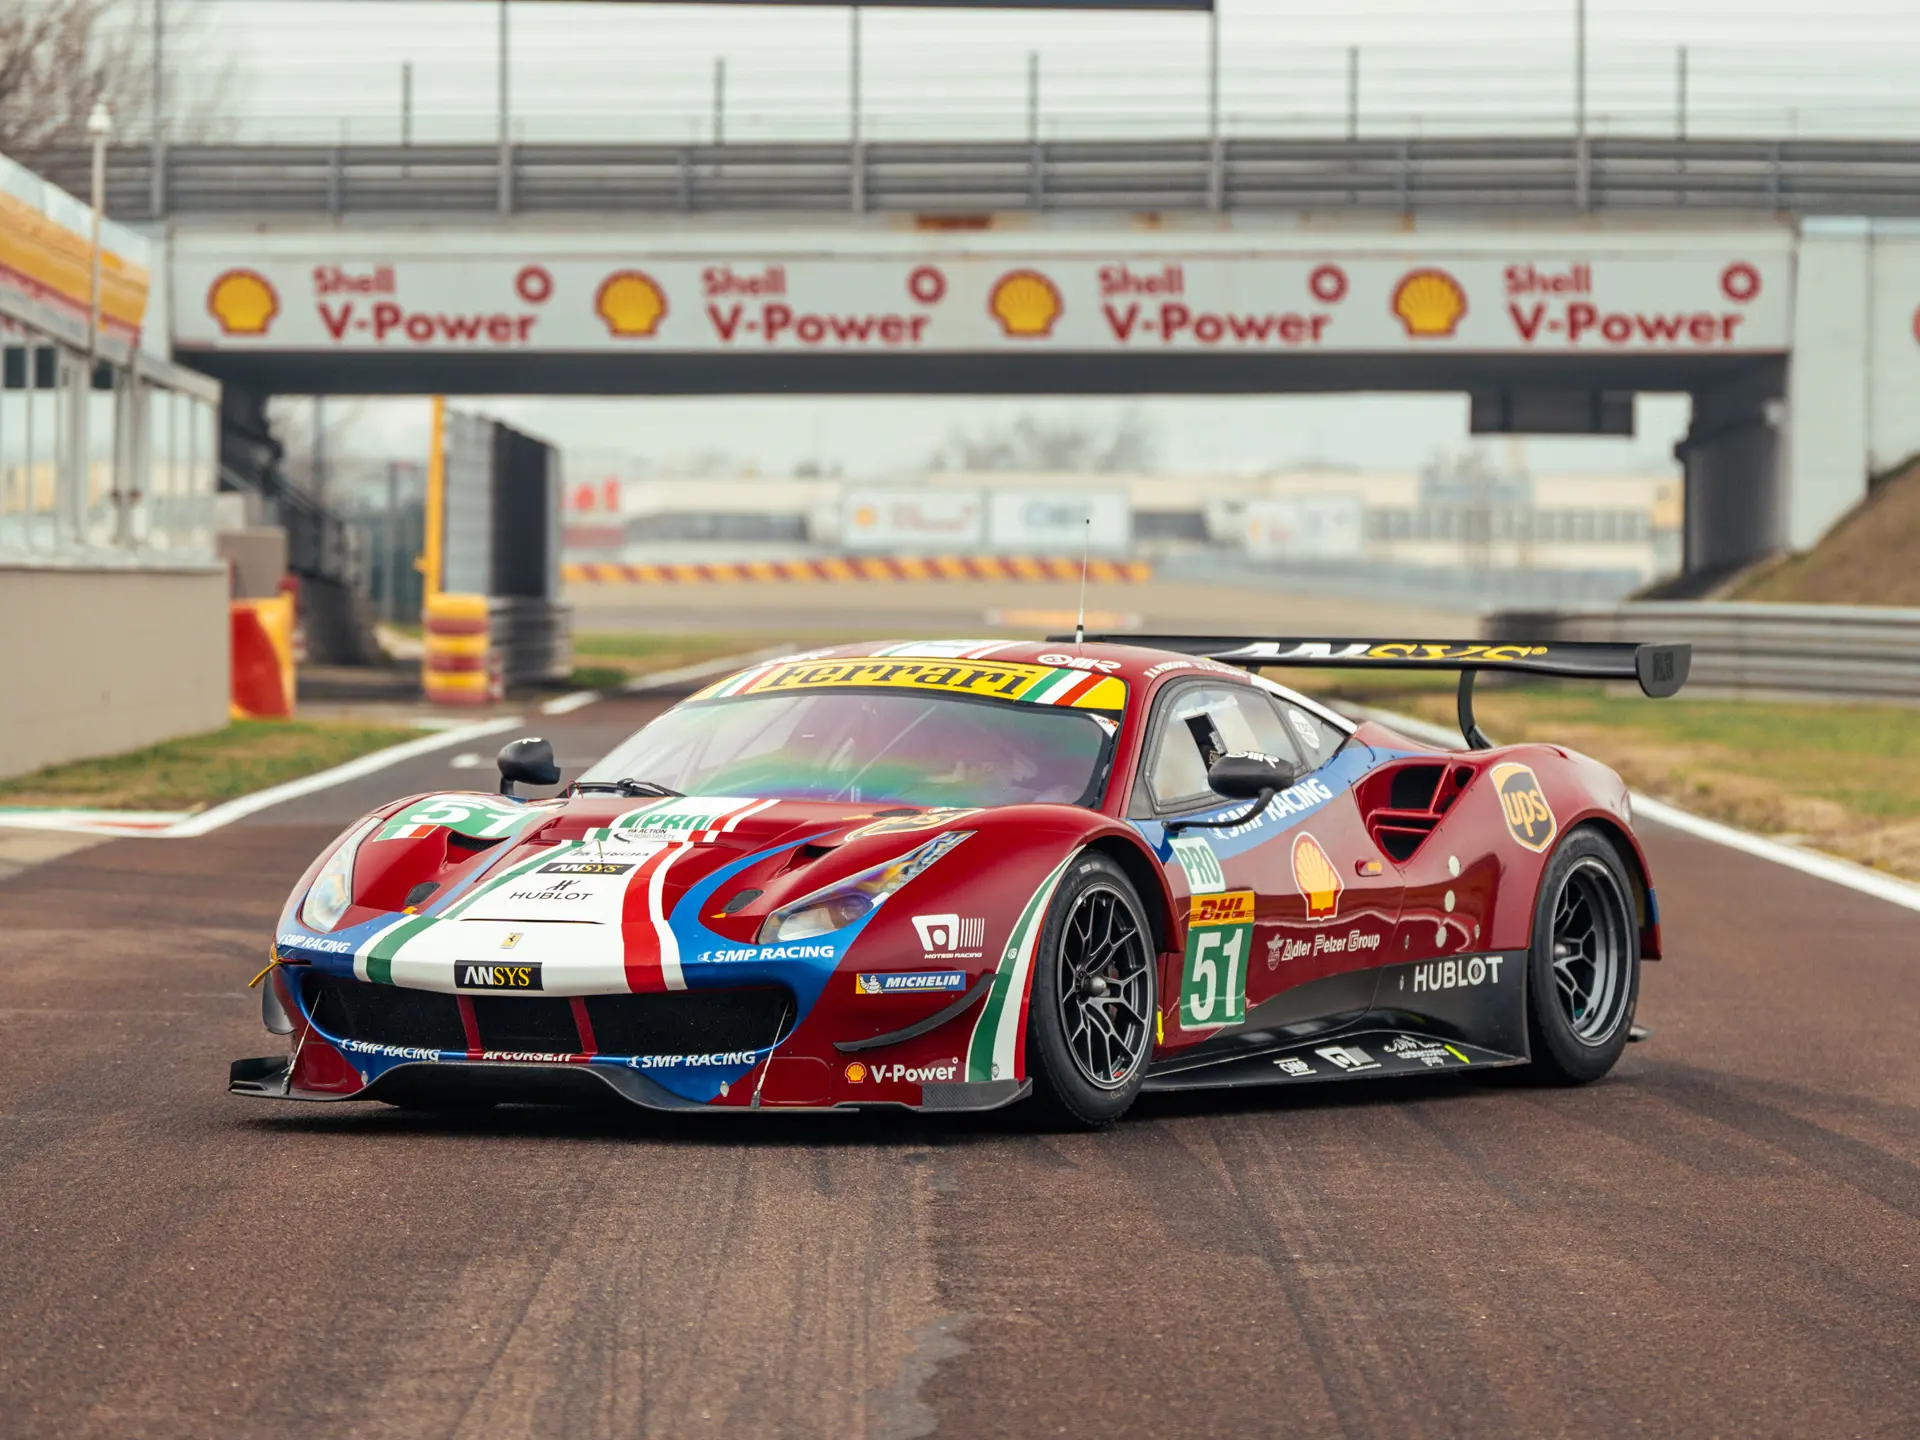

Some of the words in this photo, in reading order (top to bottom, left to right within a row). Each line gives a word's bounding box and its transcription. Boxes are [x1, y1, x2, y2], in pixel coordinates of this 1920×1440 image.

[314, 267, 395, 295] Shell
[703, 268, 785, 296] Shell
[1098, 265, 1184, 296] Shell
[1504, 264, 1591, 295] Shell
[318, 302, 538, 343] V-Power
[707, 302, 929, 343] V-Power
[1104, 301, 1332, 343] V-Power
[1507, 302, 1744, 343] V-Power
[760, 660, 1035, 696] Ferrari
[1265, 778, 1333, 821] RACING
[409, 800, 524, 837] 51
[1176, 845, 1221, 886] PRO
[509, 891, 593, 901] HUBLOT
[1198, 897, 1246, 921] DHL
[281, 934, 305, 948] SMP
[304, 935, 352, 954] RACING
[713, 949, 757, 963] SMP
[759, 945, 835, 960] RACING
[1280, 938, 1311, 961] Adler
[1313, 934, 1346, 956] Pelzer
[1347, 930, 1381, 952] Group
[463, 966, 530, 987] ANSYS
[885, 974, 961, 989] MICHELIN
[1190, 928, 1244, 1021] 51
[1413, 957, 1504, 993] HUBLOT
[349, 1041, 386, 1055] SMP
[383, 1047, 441, 1061] RACING
[641, 1055, 682, 1069] SMP
[686, 1051, 757, 1067] RACING
[870, 1061, 957, 1084] V-Power
